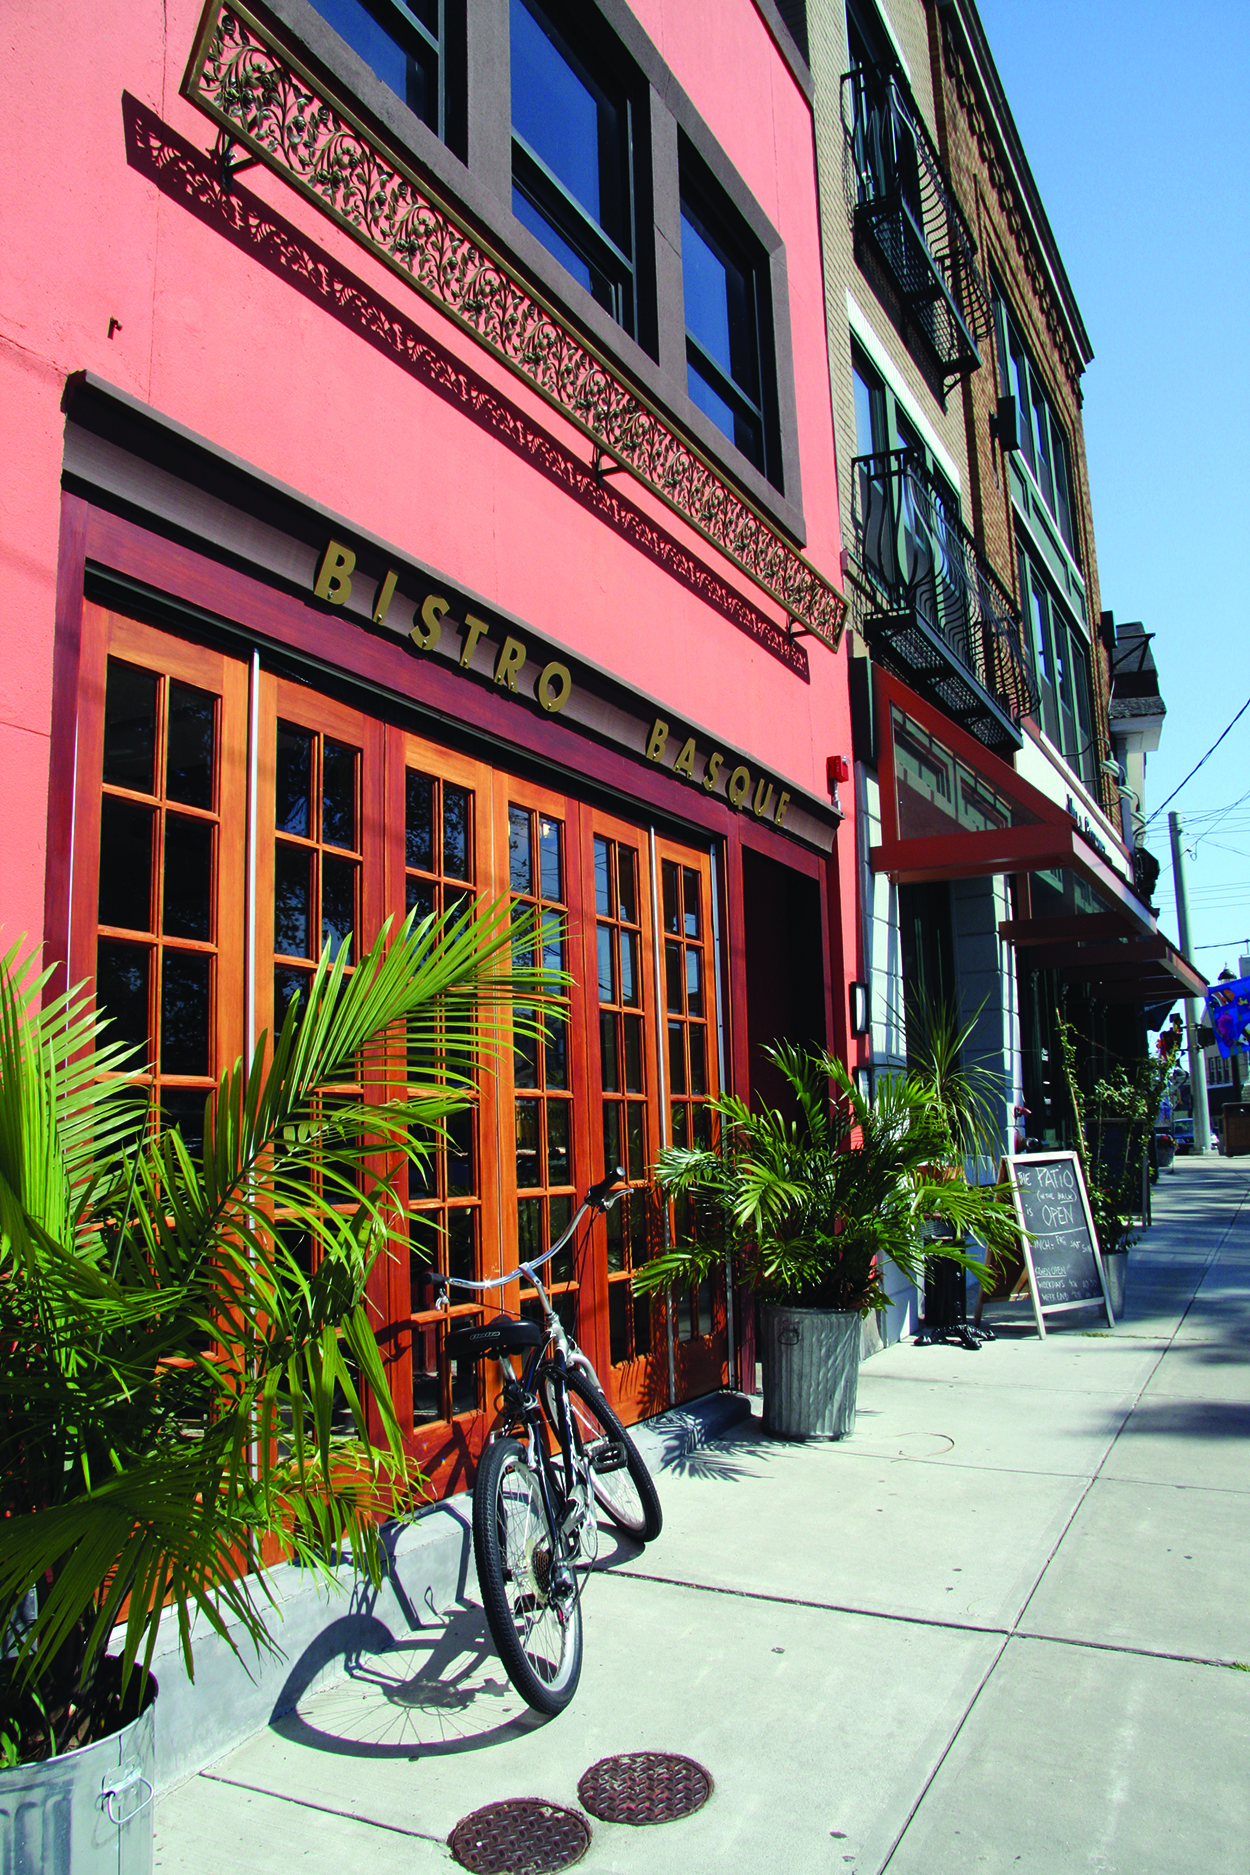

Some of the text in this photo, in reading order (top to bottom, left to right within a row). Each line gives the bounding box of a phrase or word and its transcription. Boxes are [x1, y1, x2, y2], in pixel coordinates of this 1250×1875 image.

[314, 538, 791, 827] BISTRO BASQUE
[1017, 1171, 1032, 1186] THE
[1041, 1204, 1074, 1227] OPEN
